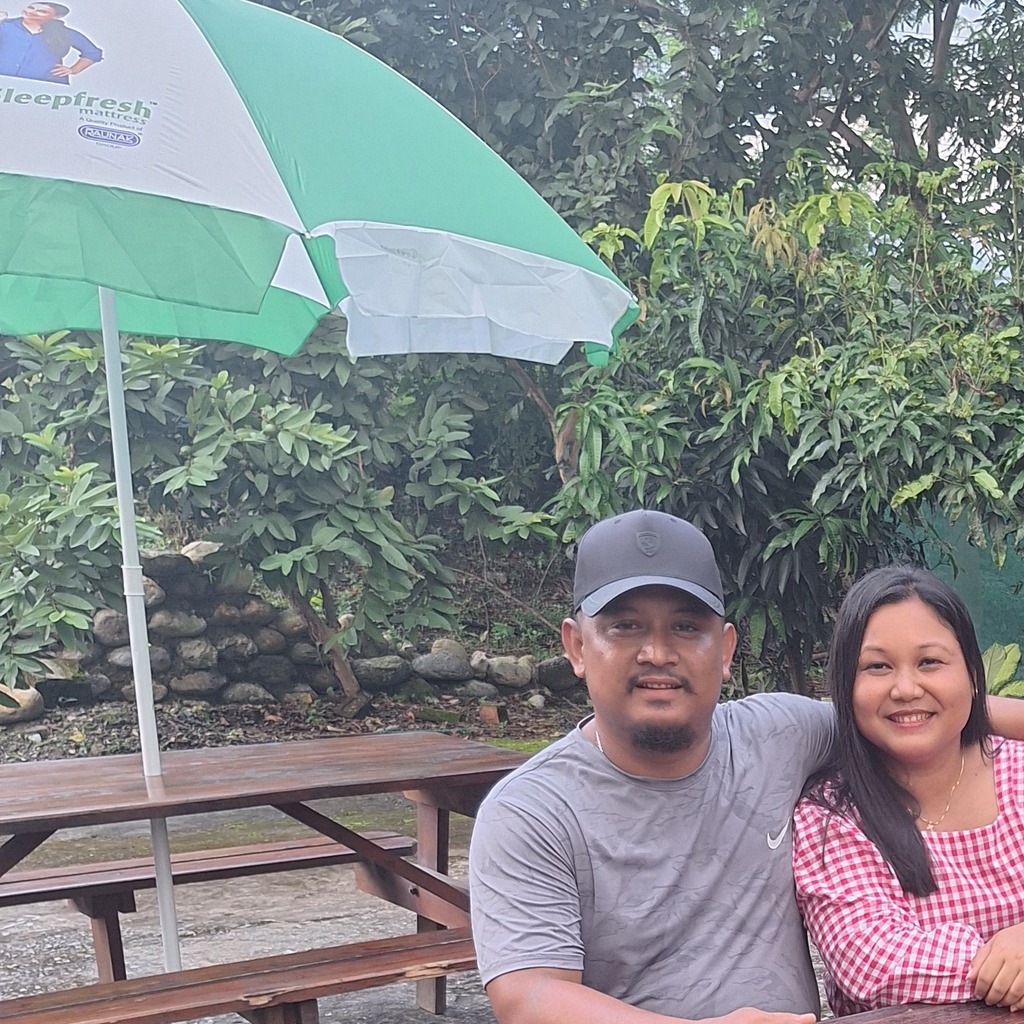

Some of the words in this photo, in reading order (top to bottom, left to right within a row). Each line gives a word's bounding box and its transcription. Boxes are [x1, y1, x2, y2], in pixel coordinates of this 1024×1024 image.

[0, 88, 151, 118] leepfresh
[80, 108, 146, 125] mattress
[85, 128, 134, 143] RAUNAK
